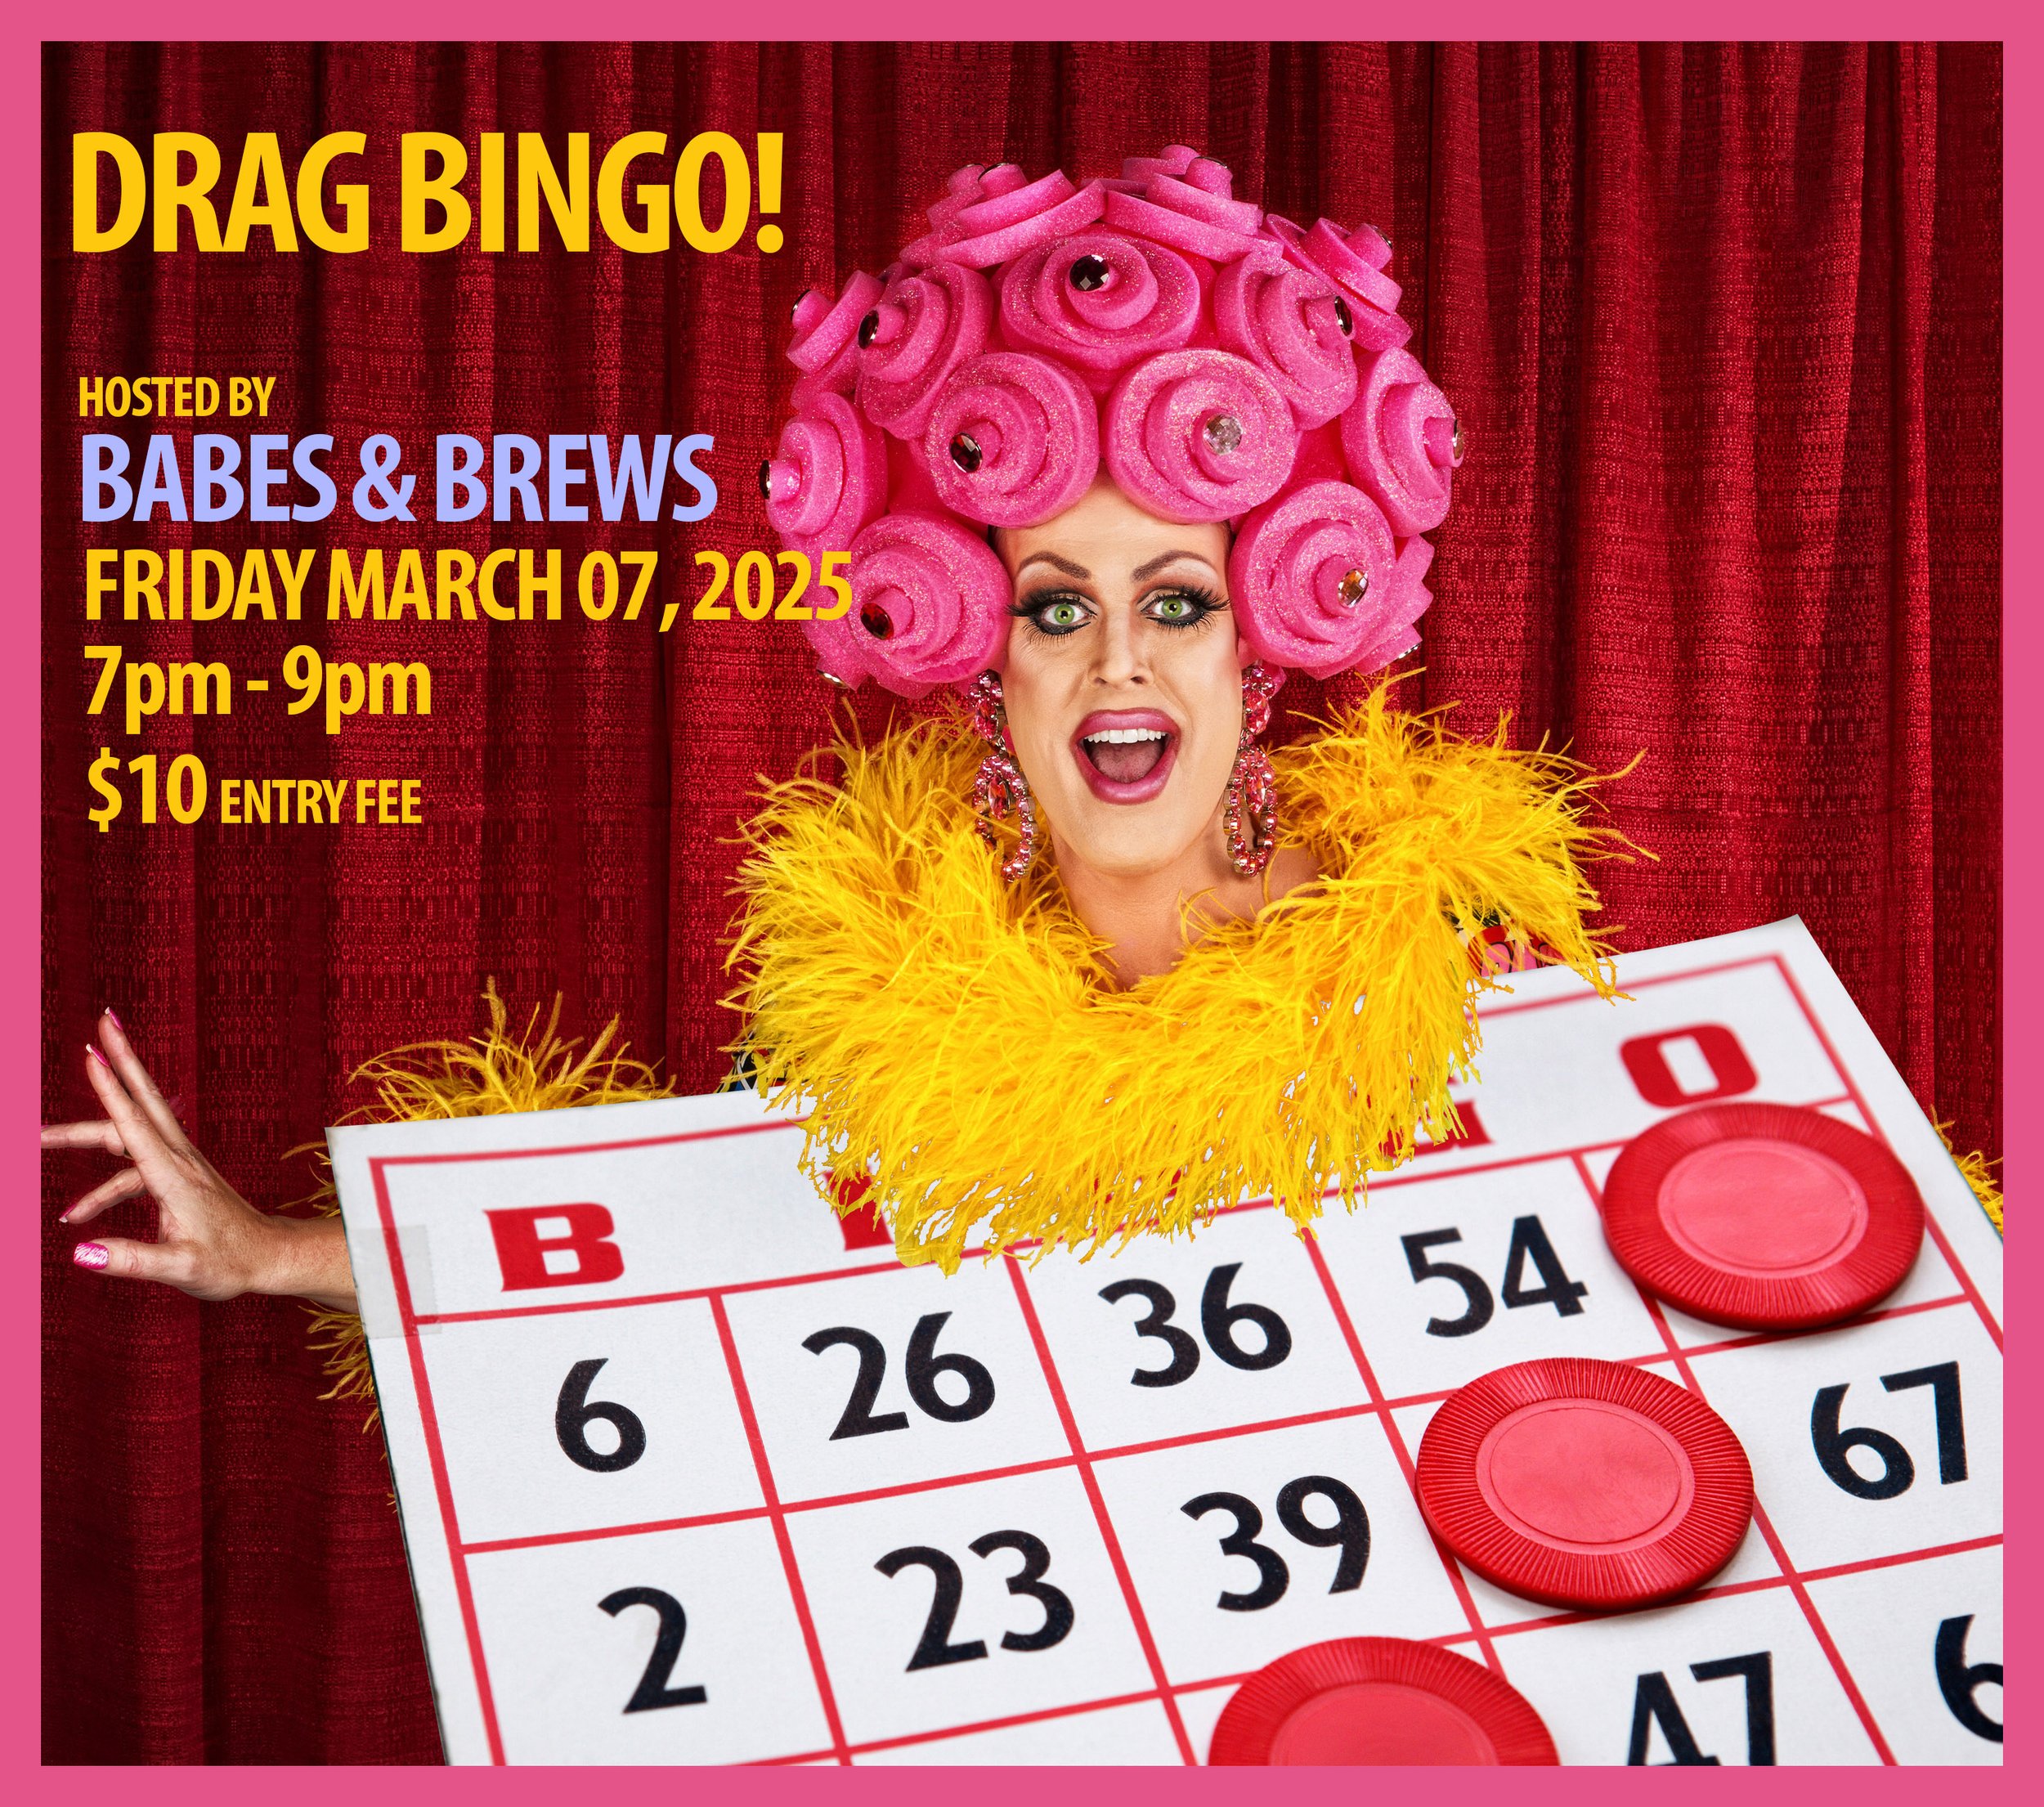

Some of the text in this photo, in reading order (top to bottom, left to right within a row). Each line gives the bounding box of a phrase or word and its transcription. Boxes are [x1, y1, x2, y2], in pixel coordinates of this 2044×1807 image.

[486, 1025, 1761, 1290] B O
[556, 1216, 1587, 1472] 6 26 36 54
[598, 1361, 1966, 1713] 2 23 39 67
[1629, 1652, 1775, 1765] 47
